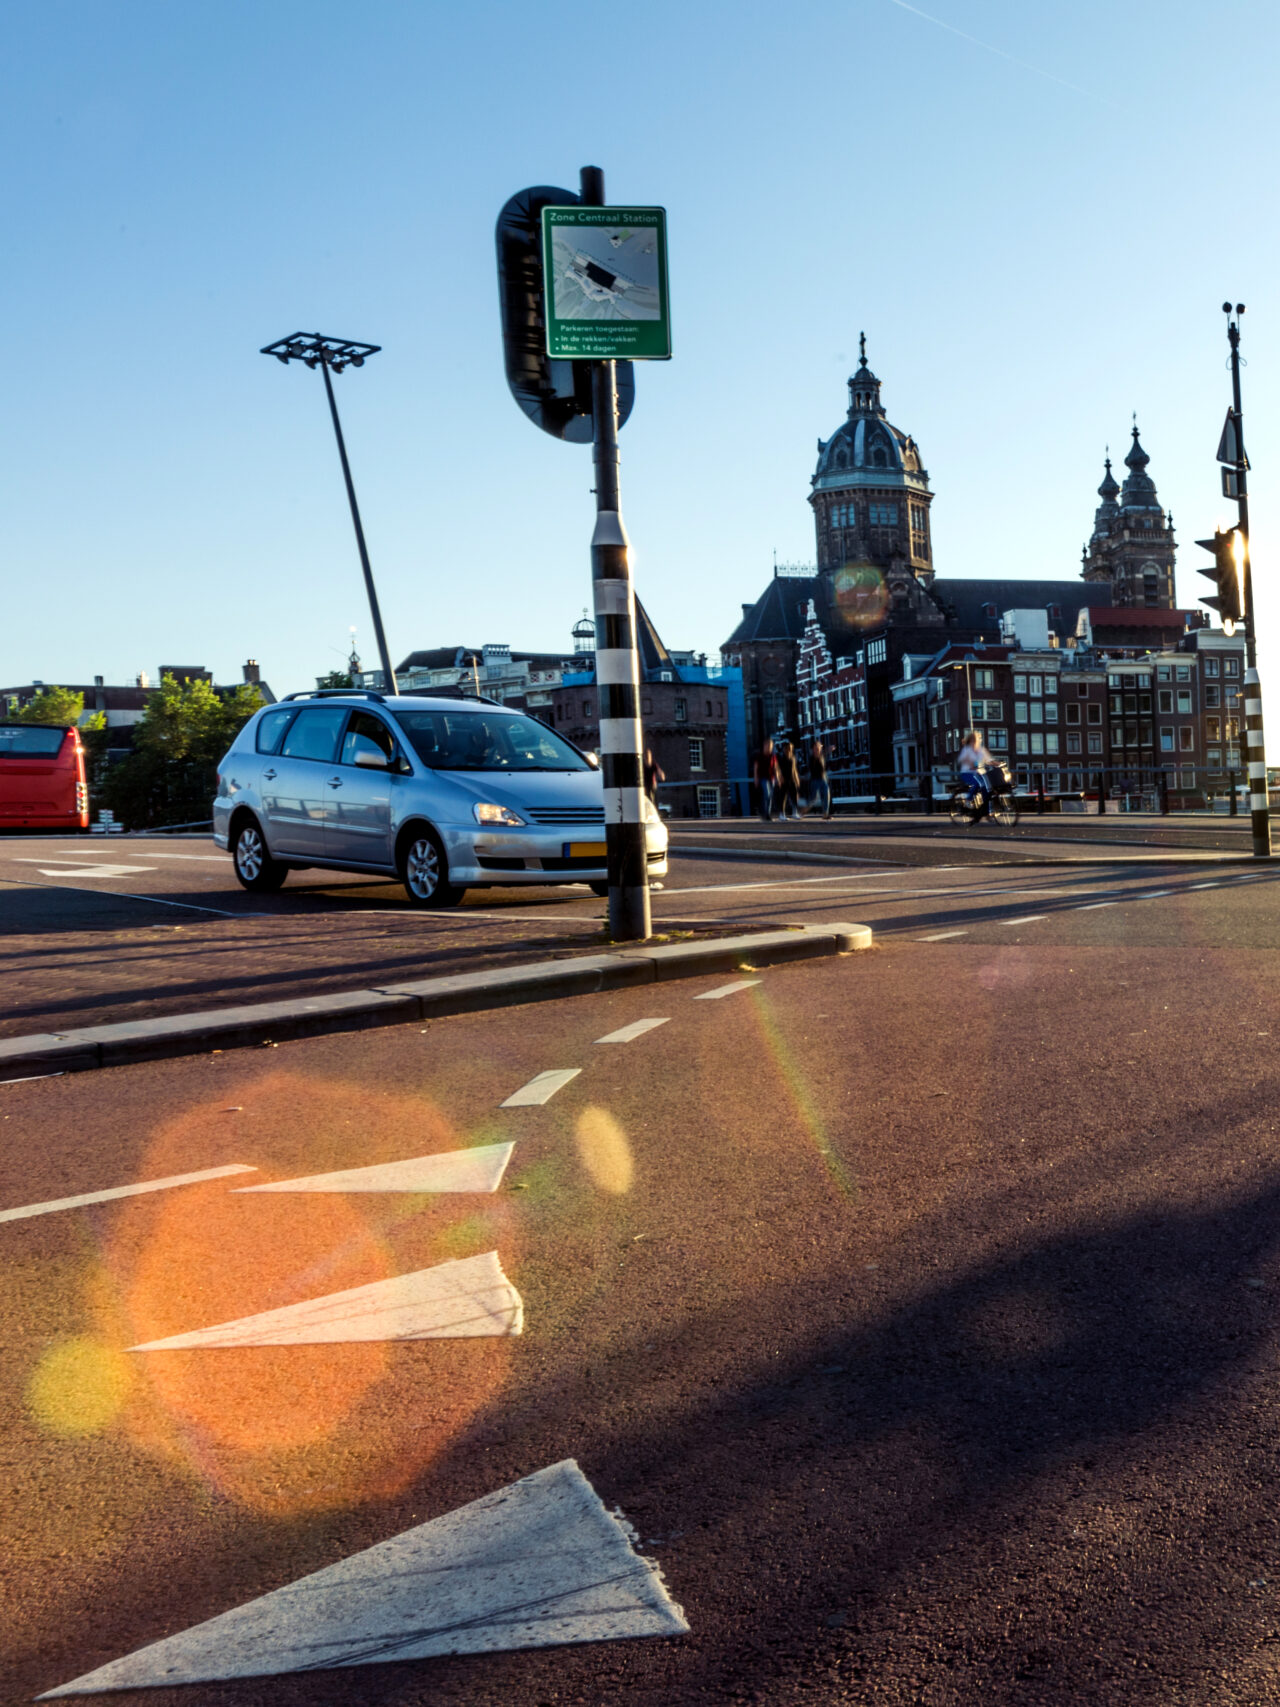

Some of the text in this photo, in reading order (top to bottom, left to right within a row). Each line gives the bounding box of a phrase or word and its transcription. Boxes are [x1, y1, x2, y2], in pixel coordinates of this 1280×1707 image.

[550, 212, 658, 223] Zone Centraal Station
[593, 344, 617, 353] dagen
